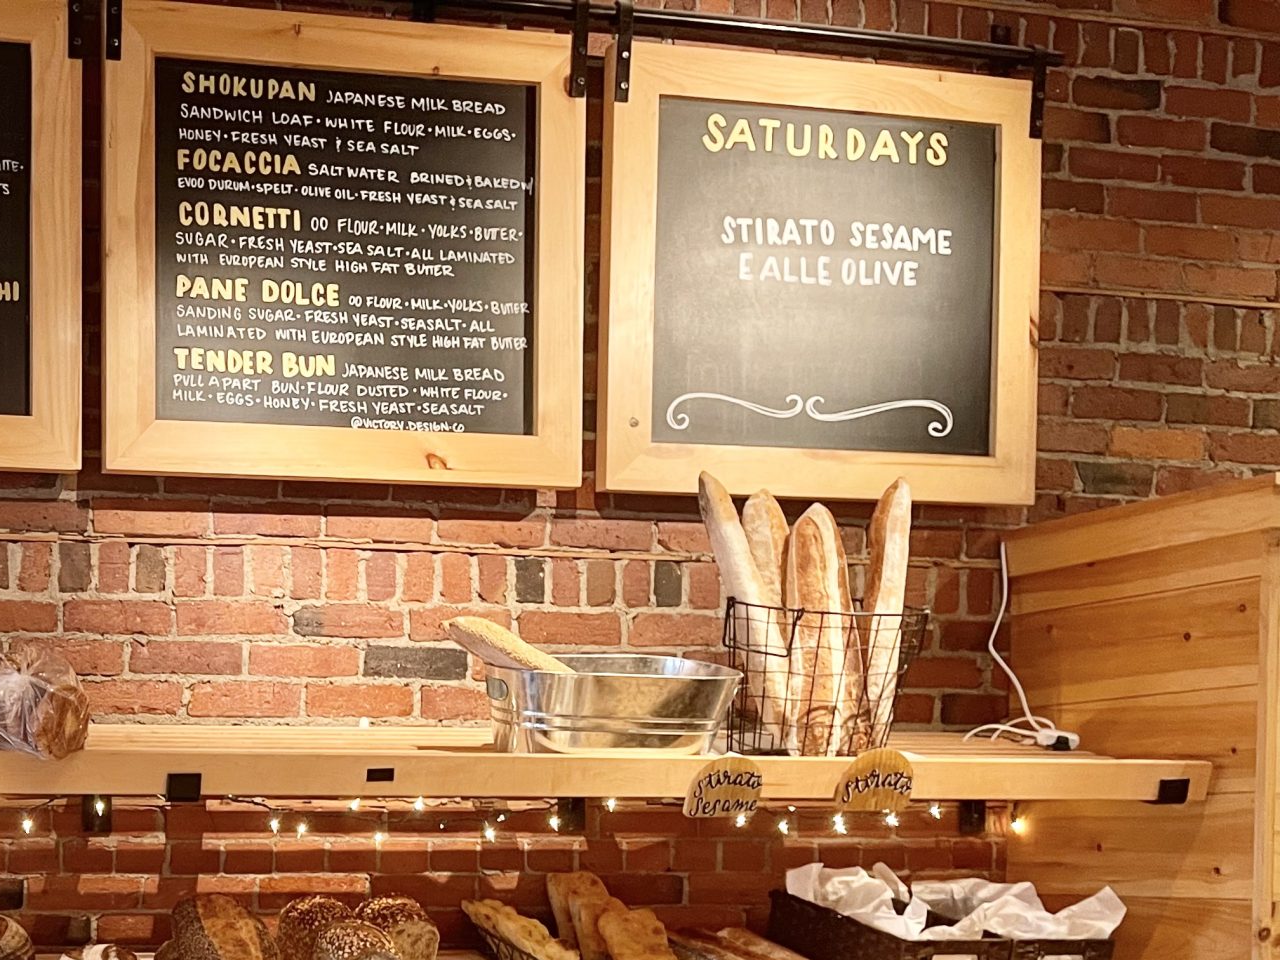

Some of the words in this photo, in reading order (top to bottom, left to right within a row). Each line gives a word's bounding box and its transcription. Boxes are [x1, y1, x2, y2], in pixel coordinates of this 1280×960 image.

[181, 71, 316, 102] SHOKUPAN
[326, 90, 406, 109] JAPANESE
[411, 97, 449, 112] MILK
[452, 100, 506, 115] BREAD
[180, 103, 263, 124] SANDWICH
[283, 134, 327, 150] YEAST
[347, 140, 376, 152] SEA
[380, 143, 420, 156] SALT
[702, 113, 948, 166] SATURDAYS
[177, 148, 301, 175] FOCACCIA
[178, 201, 301, 232] CORNETTI
[428, 224, 467, 239] YOLKS
[721, 216, 834, 246] STIRATO
[849, 221, 952, 255] SESAME
[176, 253, 209, 265] WITH
[219, 254, 284, 268] EUROPEAN
[291, 257, 326, 272] STYLE
[335, 260, 368, 274] HIGH
[370, 262, 400, 274] FAT
[404, 263, 455, 277] BUTTER
[439, 250, 516, 264] LAMINATED
[739, 253, 752, 280] E
[760, 256, 831, 286] ALLE
[841, 258, 918, 286] OLIVE
[175, 274, 249, 302] PANE
[262, 279, 340, 307] DOLCE
[176, 304, 242, 321] SANDING
[469, 320, 496, 333] ALL
[177, 324, 267, 340] LAMINATED
[275, 328, 307, 342] WITH
[311, 330, 385, 346] EUROPEAN
[390, 334, 428, 348] STYLE
[432, 335, 460, 349] HIGH
[462, 337, 486, 349] FAT
[173, 347, 273, 376] TENDER
[282, 352, 336, 378] BUN
[342, 362, 409, 380] JAPANESE
[414, 368, 449, 381] MILK
[453, 368, 505, 382] BREAD
[173, 373, 204, 387] PULL
[357, 384, 409, 398] DUSTED
[372, 402, 415, 415] YEAST
